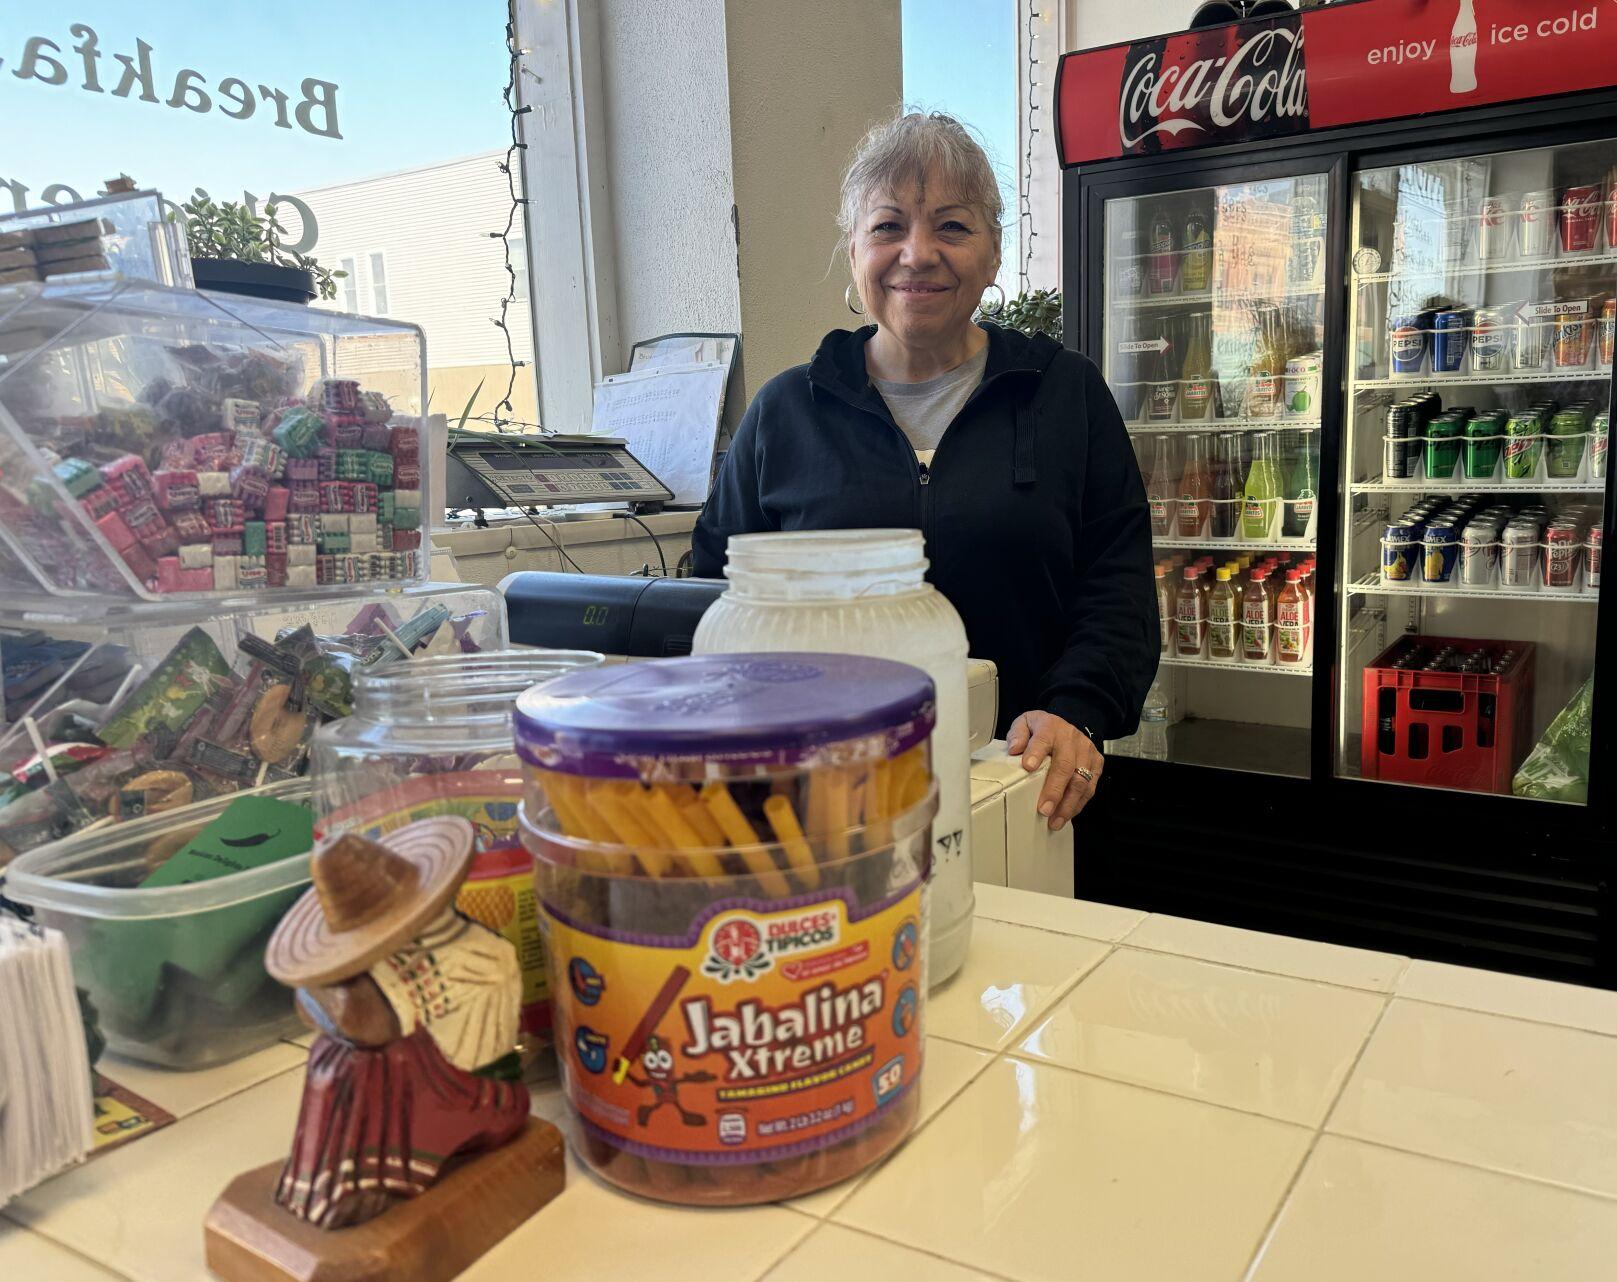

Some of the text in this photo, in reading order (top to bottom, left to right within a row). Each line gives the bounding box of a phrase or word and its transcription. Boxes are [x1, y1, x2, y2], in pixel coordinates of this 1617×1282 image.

[1490, 7, 1598, 45] ice cold
[1367, 38, 1437, 65] enjoy
[1120, 25, 1308, 148] Coca-Cola
[1535, 304, 1581, 315] Slide To Open
[1142, 342, 1159, 350] Open
[1393, 339, 1422, 348] PEPSI
[1472, 335, 1503, 344] PEPSI
[1178, 606, 1196, 615] ALOE
[1211, 608, 1229, 617] ALOE
[1246, 610, 1264, 619] ALOE
[1280, 612, 1299, 620] ALOE
[768, 911, 830, 938] DULCES
[684, 979, 883, 1056] Jabalina
[729, 1023, 864, 1079] Xtreme
[719, 1082, 789, 1099] TAMARIND
[837, 1054, 873, 1077] CANDY
[878, 1063, 902, 1094] 50
